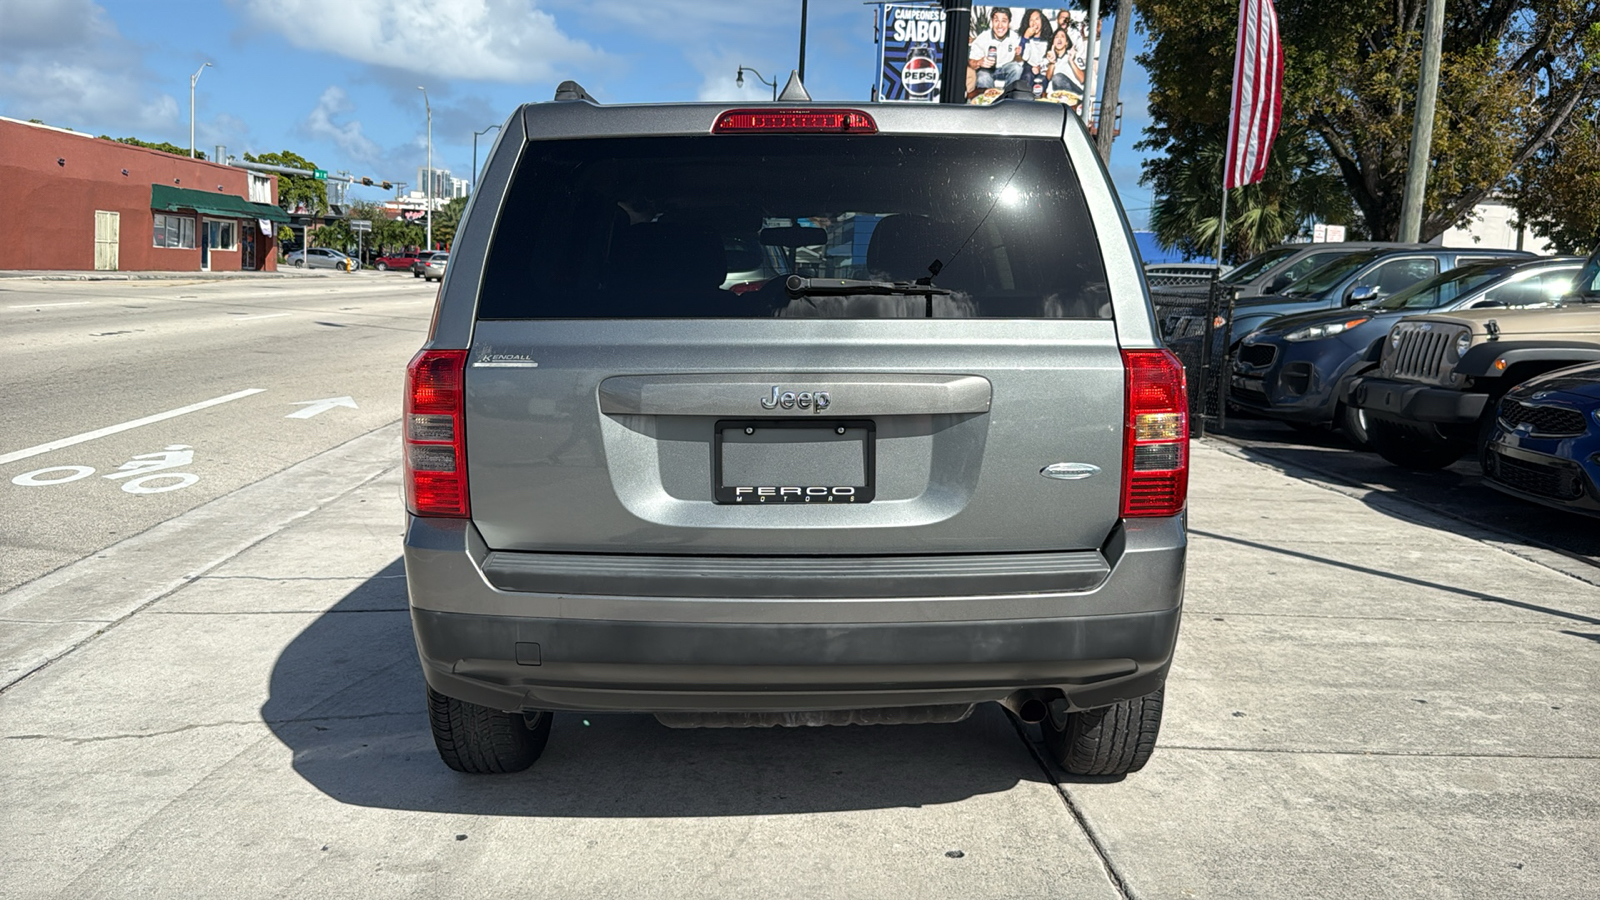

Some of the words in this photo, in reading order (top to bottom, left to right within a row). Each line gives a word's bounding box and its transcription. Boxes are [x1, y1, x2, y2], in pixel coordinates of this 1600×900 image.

[895, 8, 939, 20] CAMPEONES
[1077, 57, 1085, 67] 9
[904, 72, 936, 80] PEPSI
[760, 385, 831, 414] Jeep
[736, 487, 855, 495] FERCO
